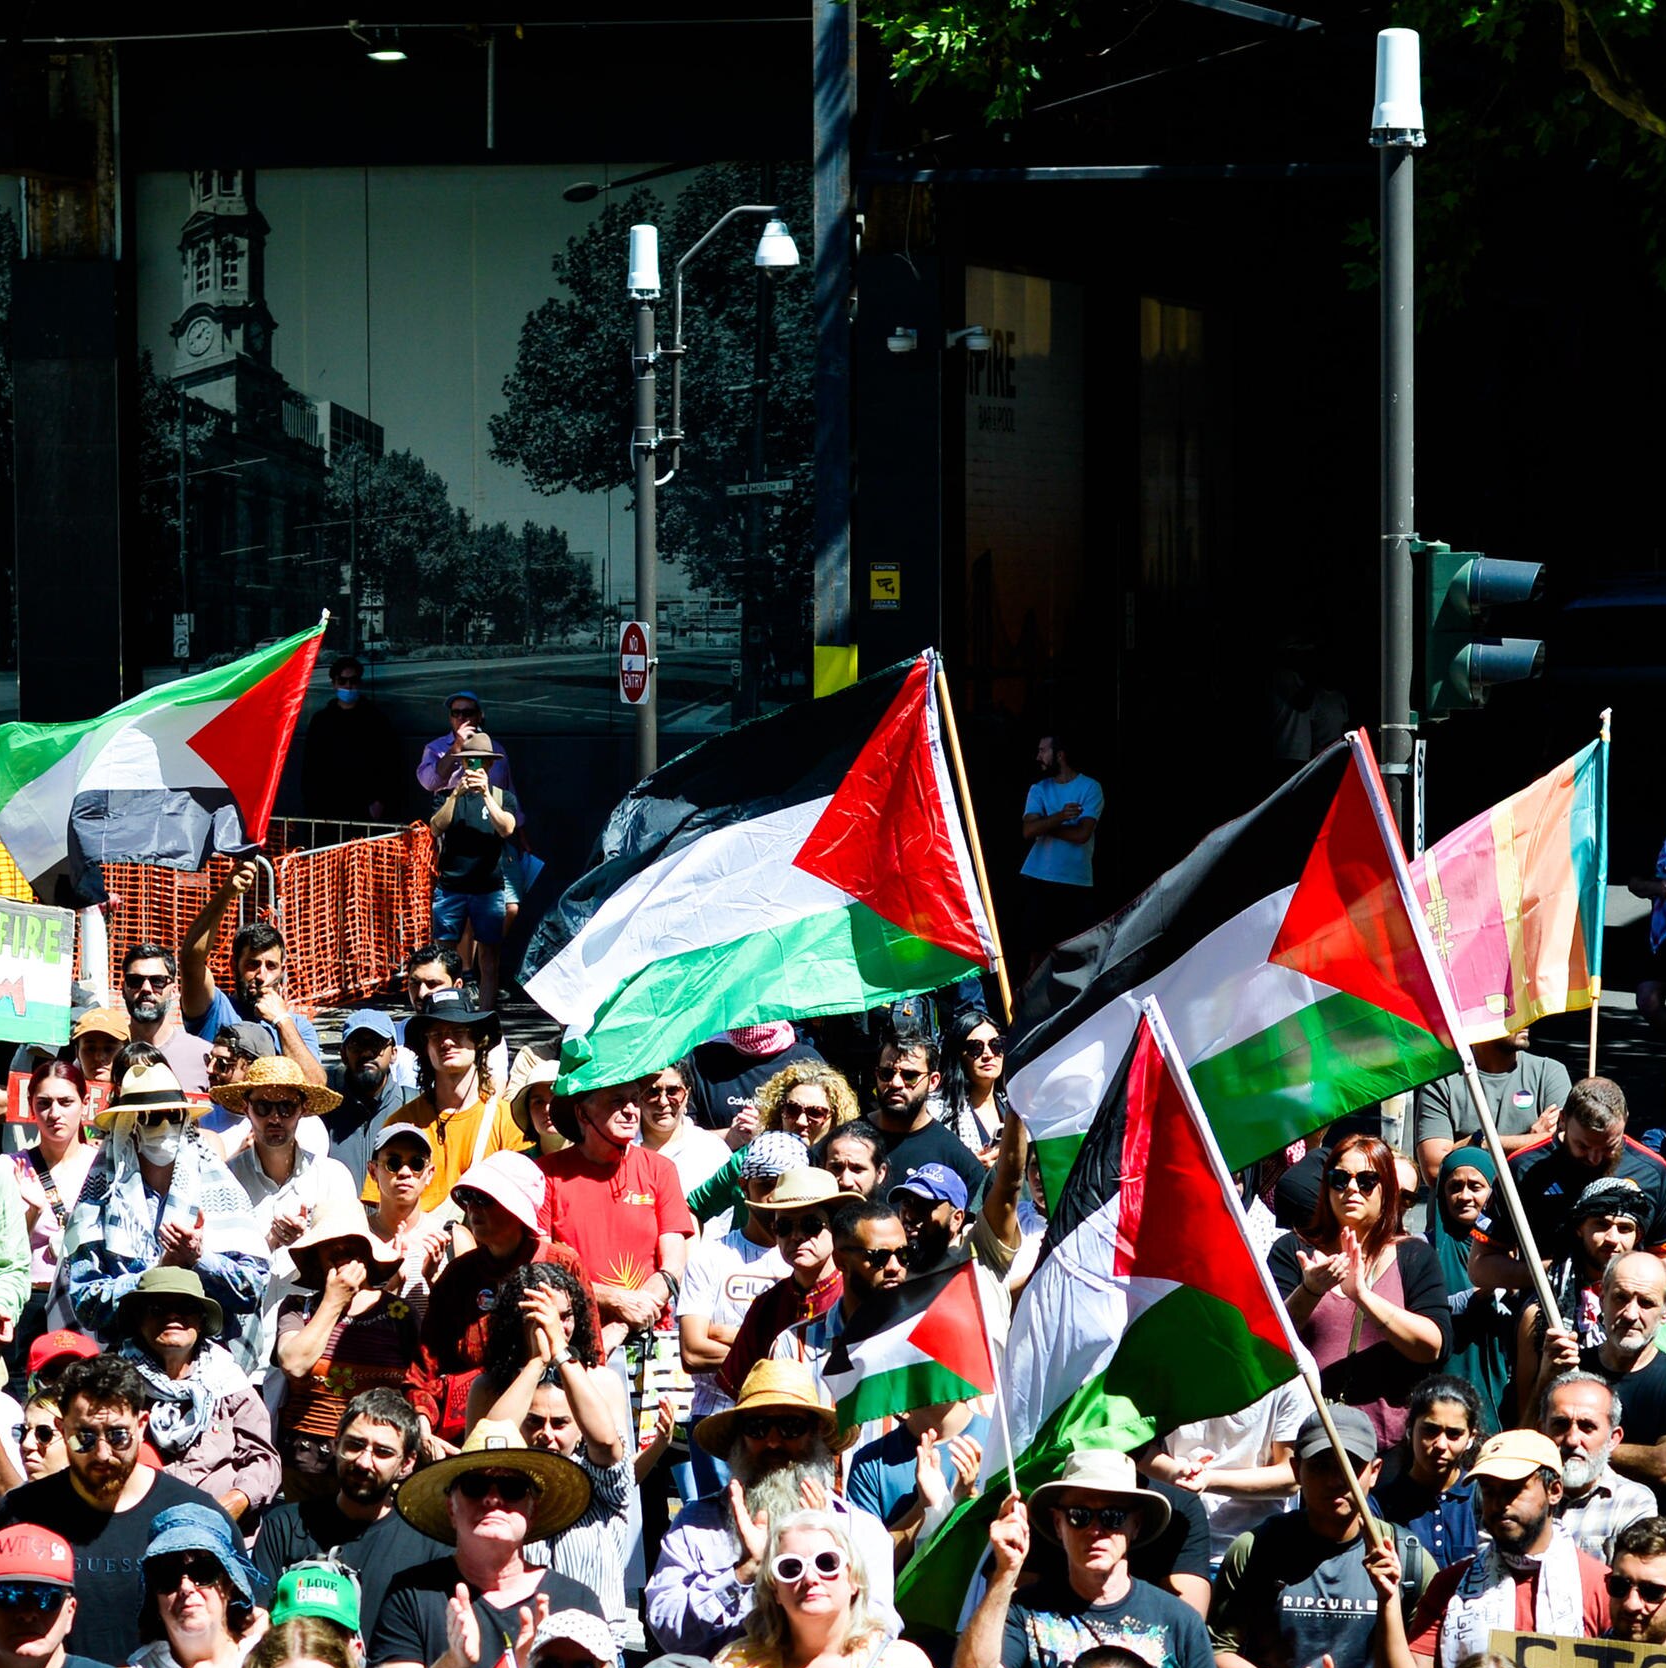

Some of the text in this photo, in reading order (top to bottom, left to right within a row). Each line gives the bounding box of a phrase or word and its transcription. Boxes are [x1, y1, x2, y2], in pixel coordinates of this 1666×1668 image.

[629, 637, 638, 652] NO
[624, 673, 642, 689] ENTRY
[306, 1578, 338, 1592] LOVE
[1282, 1595, 1363, 1611] RIPCURL
